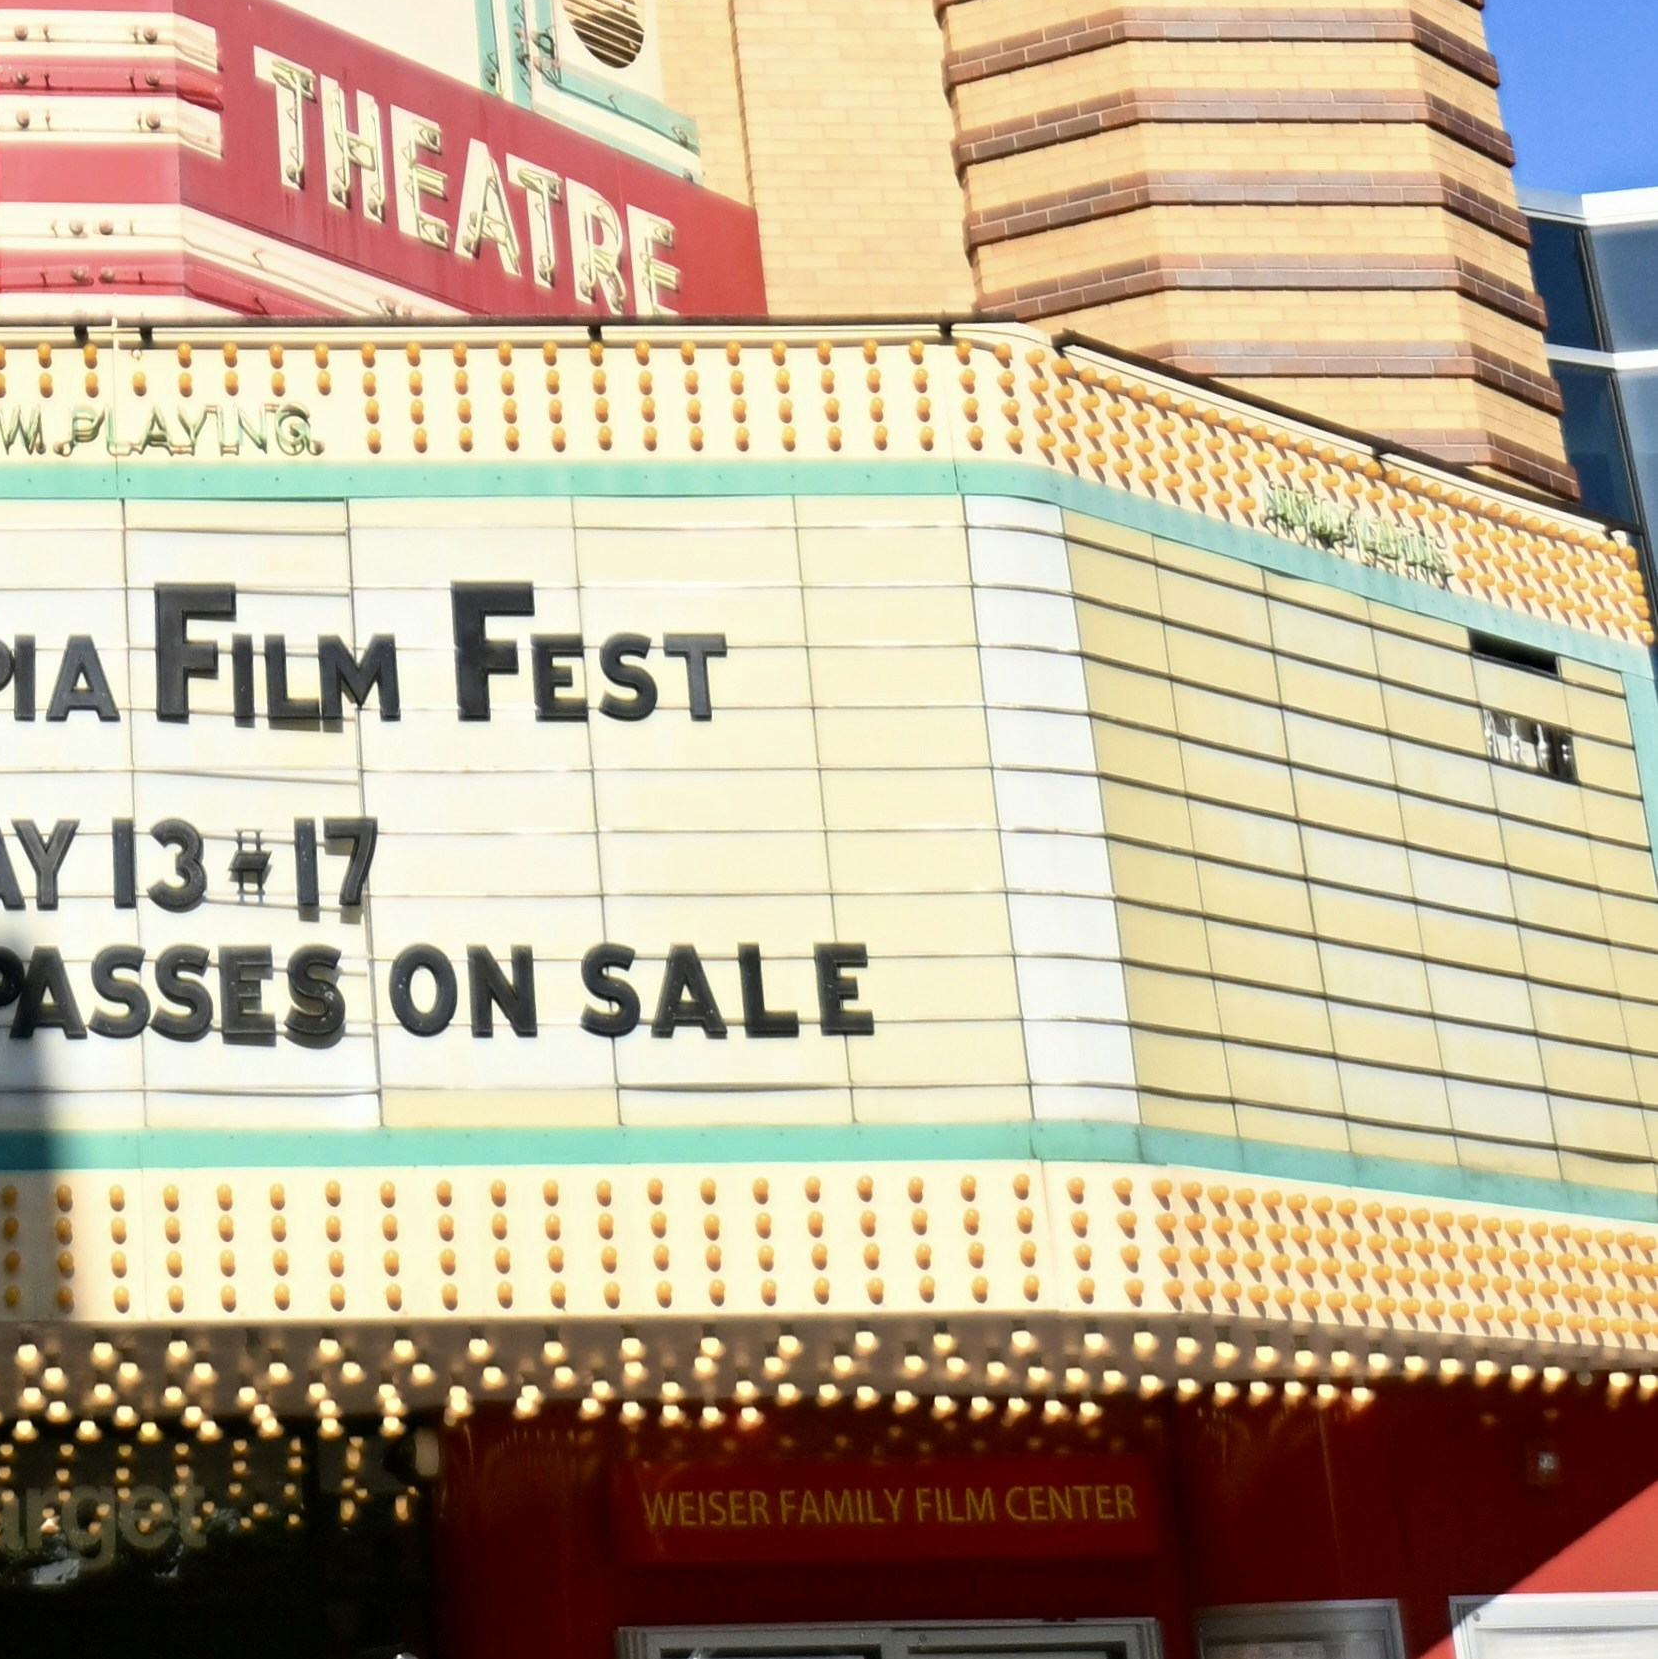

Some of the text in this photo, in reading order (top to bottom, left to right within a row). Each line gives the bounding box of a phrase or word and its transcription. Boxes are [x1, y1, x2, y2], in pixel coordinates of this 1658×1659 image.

[253, 44, 682, 317] THEATRE
[53, 402, 326, 457] PLAYING
[388, 942, 538, 1039] ON
[580, 942, 876, 1039] SALE
[642, 1484, 1139, 1527] WEISER FAMILY FILM CENTER
